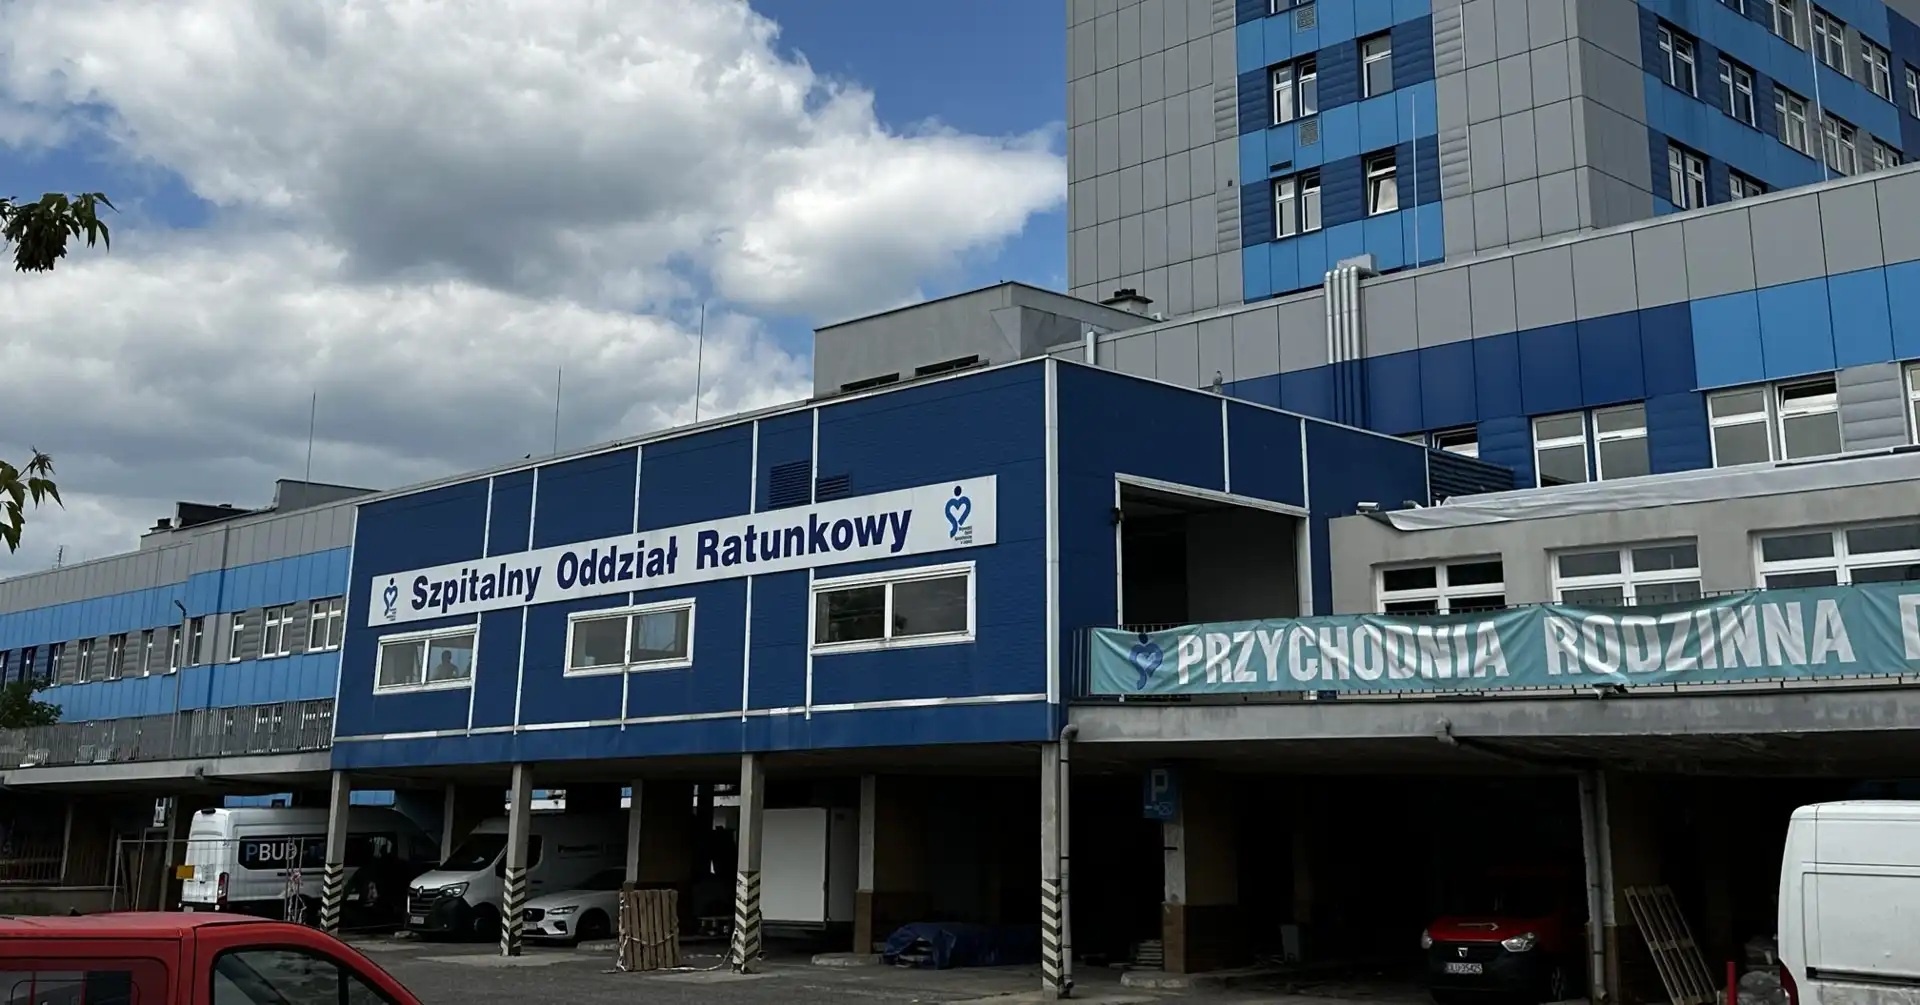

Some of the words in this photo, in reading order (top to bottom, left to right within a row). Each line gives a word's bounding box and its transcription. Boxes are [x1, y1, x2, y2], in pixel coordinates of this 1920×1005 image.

[411, 563, 542, 614] Szpitalny
[557, 535, 678, 590] Oddział
[696, 509, 912, 570] Ratunkowy
[1178, 621, 1509, 685] PRZYCHODNIA
[1544, 599, 1856, 675] RODZINNA
[1151, 769, 1168, 802] P
